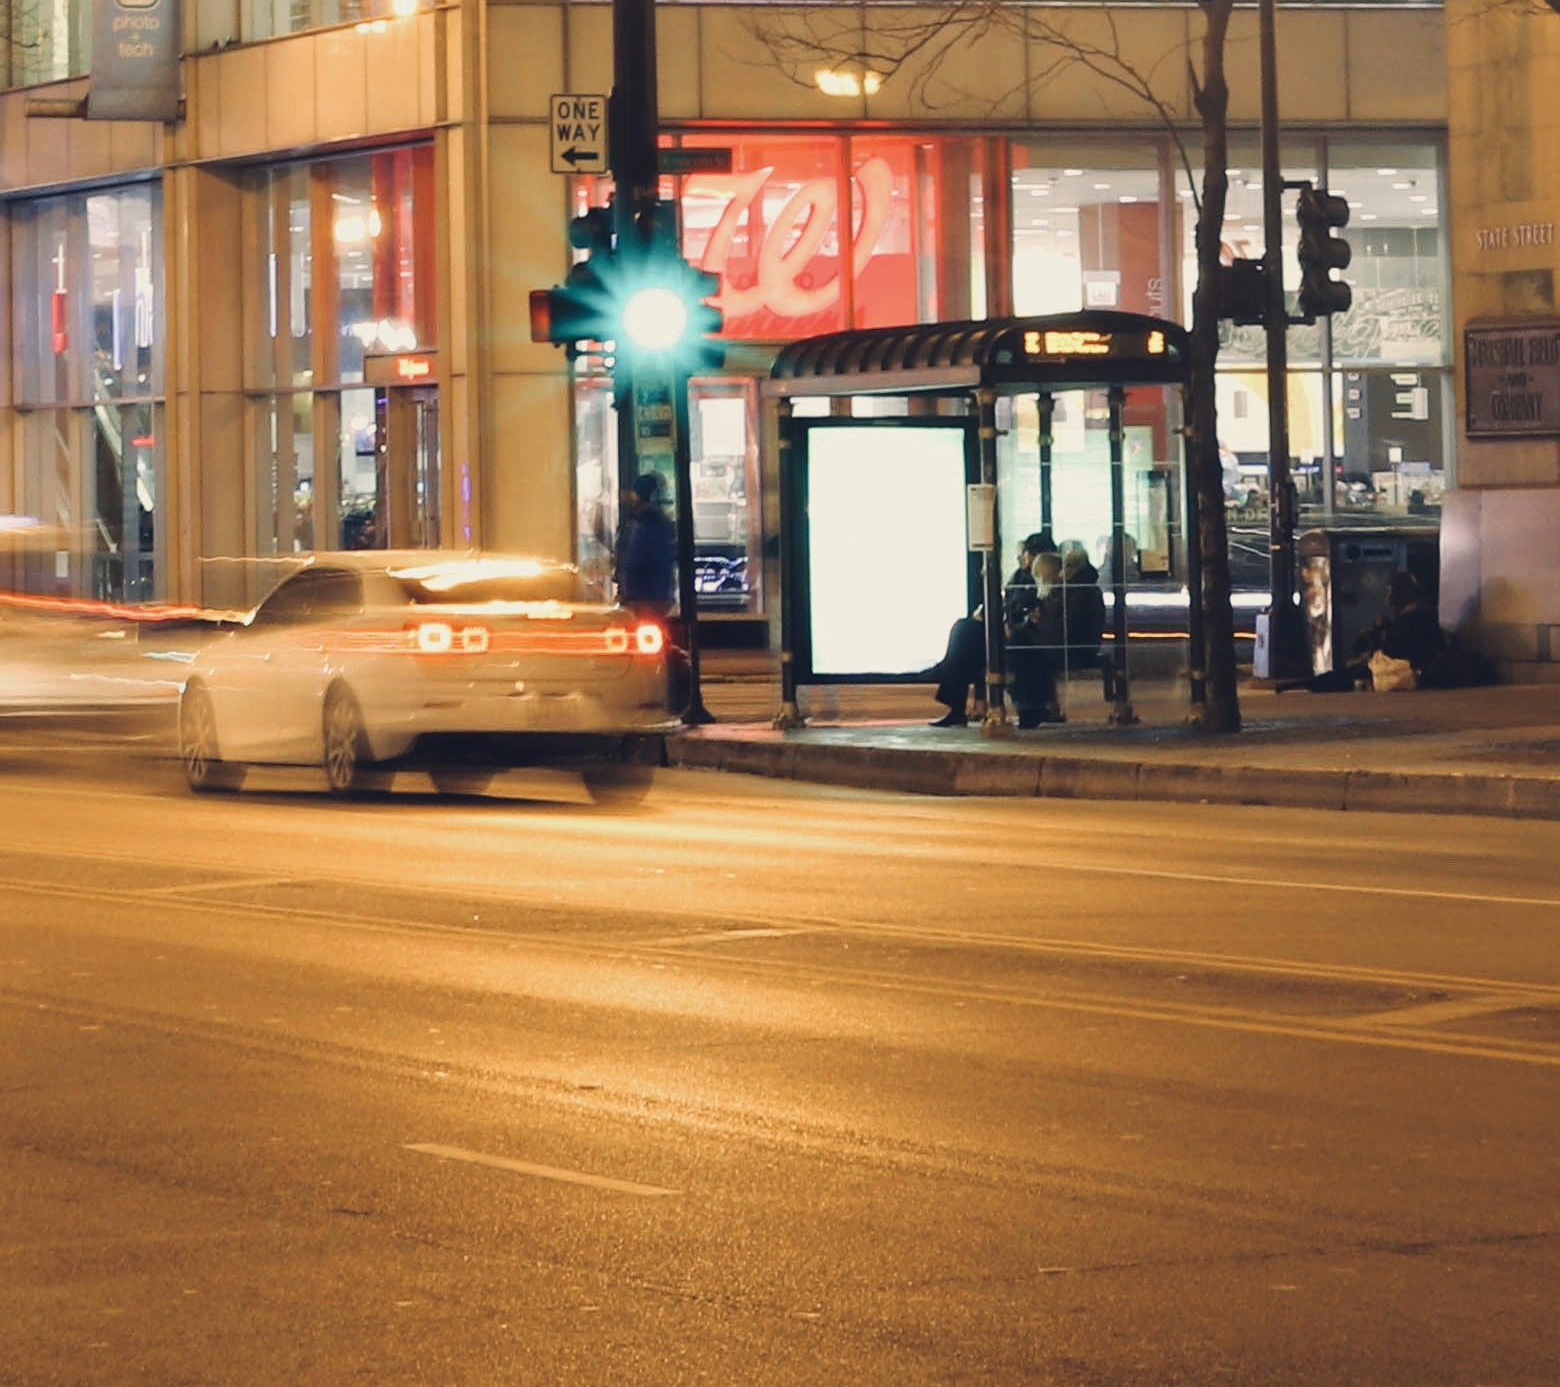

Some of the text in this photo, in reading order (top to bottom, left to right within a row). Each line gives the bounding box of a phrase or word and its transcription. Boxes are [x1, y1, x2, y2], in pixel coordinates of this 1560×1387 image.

[112, 16, 160, 33] photo
[119, 42, 154, 57] tech
[557, 102, 600, 120] ONE
[557, 124, 601, 142] WAY
[1475, 223, 1554, 251] STATE STREET
